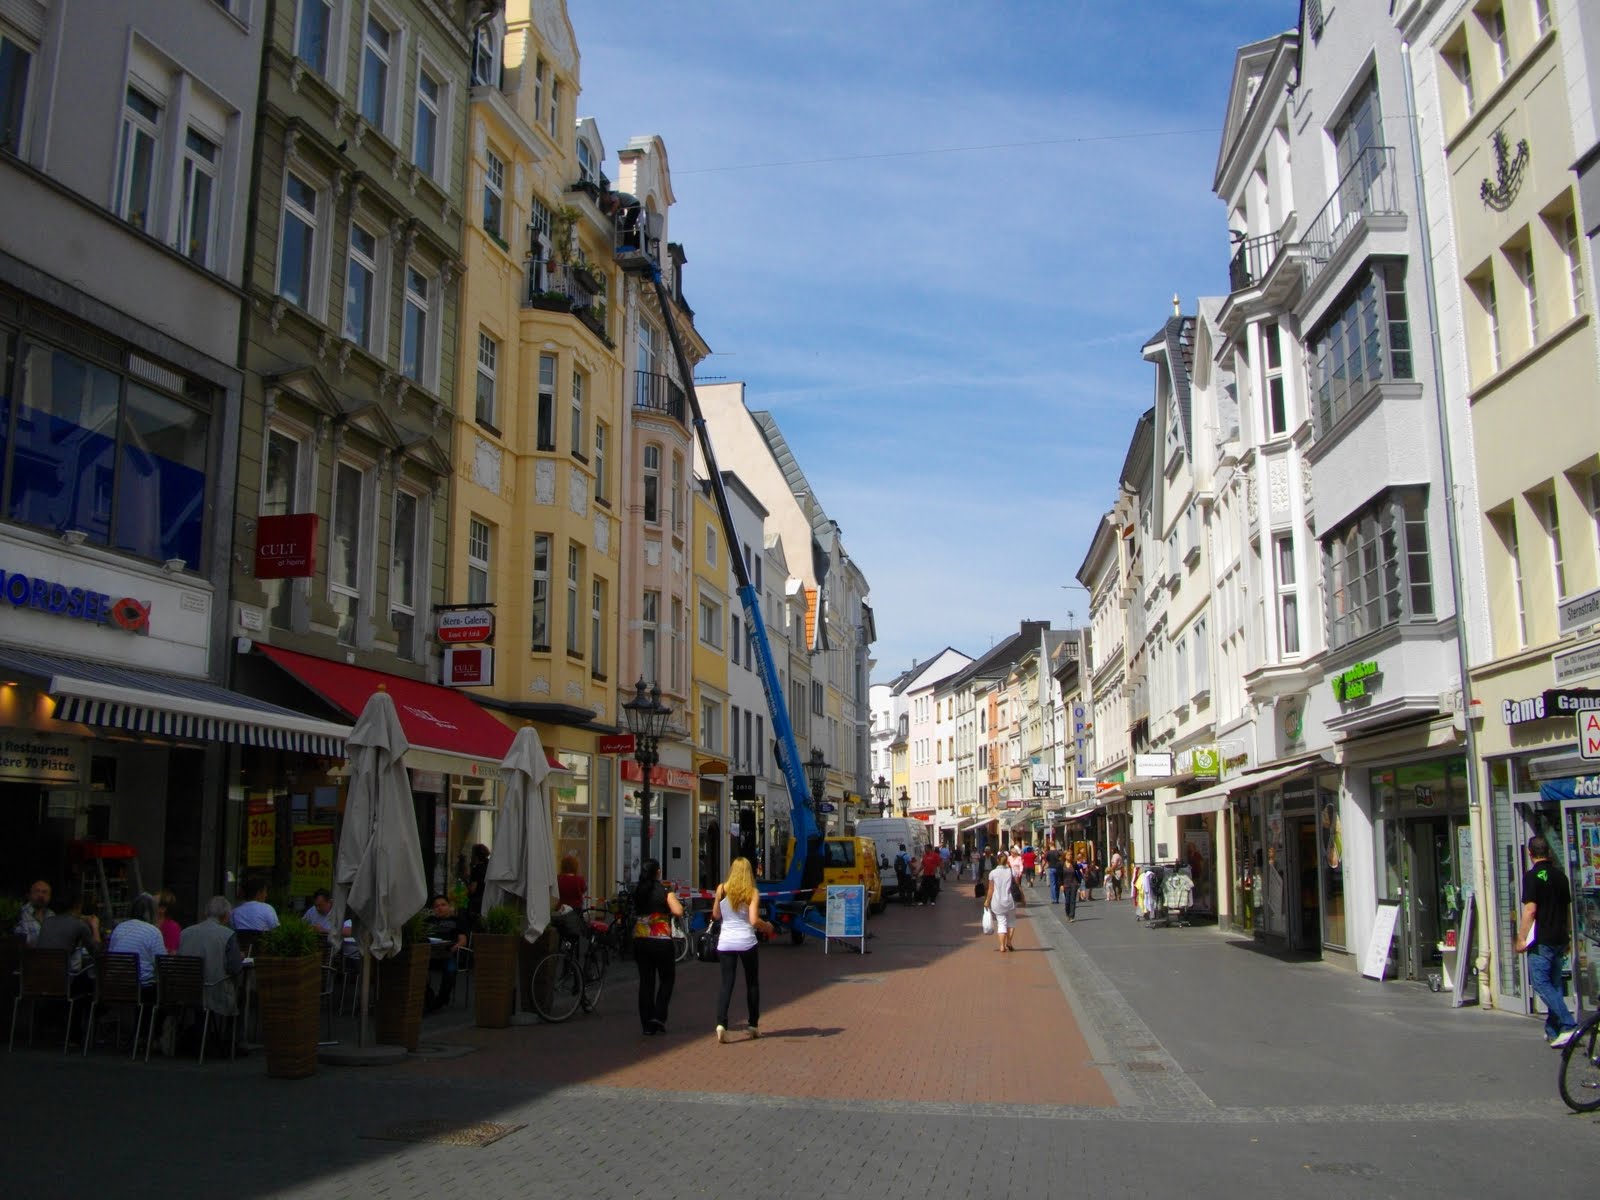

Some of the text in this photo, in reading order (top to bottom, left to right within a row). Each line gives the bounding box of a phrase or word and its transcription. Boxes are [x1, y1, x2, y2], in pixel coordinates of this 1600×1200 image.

[260, 543, 297, 556] CULT
[0, 568, 111, 625] ORDSEE
[1567, 597, 1599, 621] Sternstraße
[1502, 696, 1545, 726] Game
[5, 740, 69, 757] Restaurant
[1074, 707, 1085, 778] OPTIK
[25, 756, 38, 769] 70
